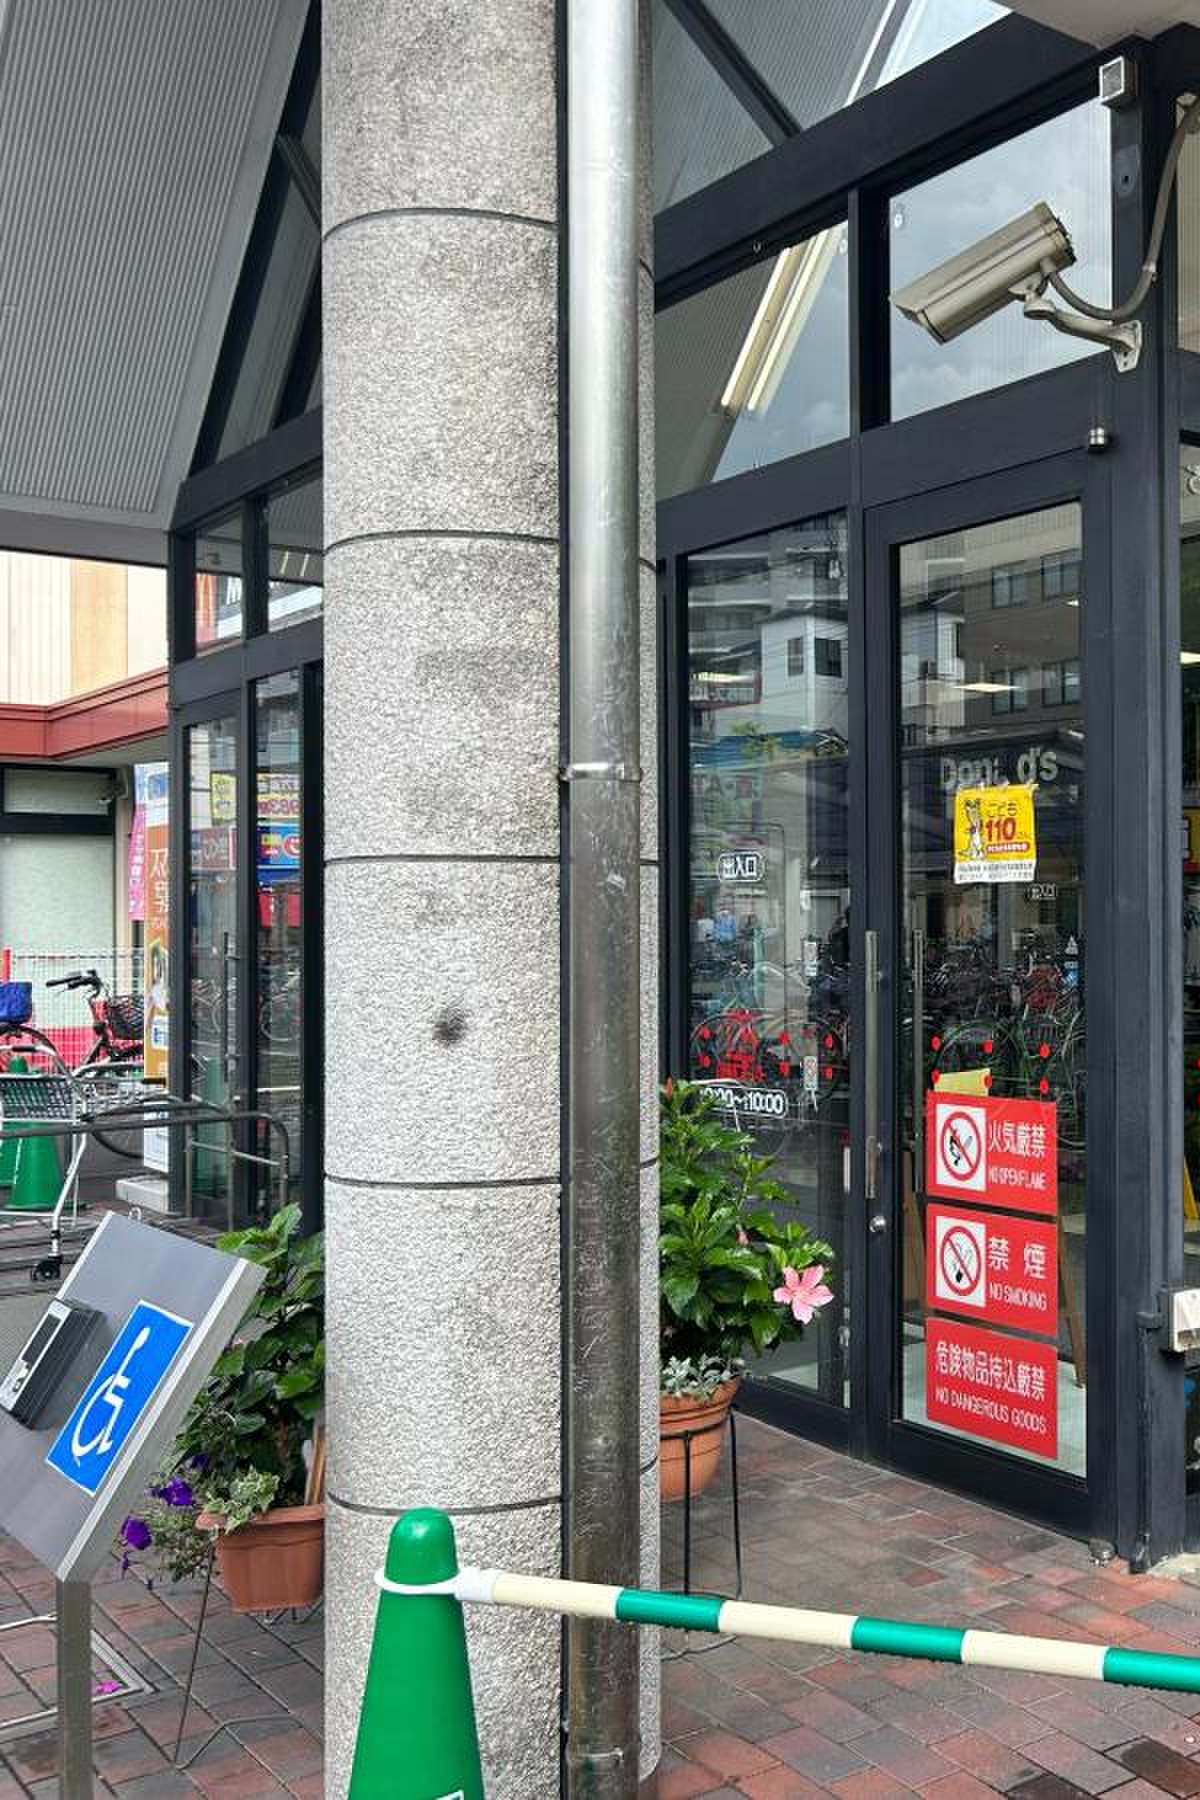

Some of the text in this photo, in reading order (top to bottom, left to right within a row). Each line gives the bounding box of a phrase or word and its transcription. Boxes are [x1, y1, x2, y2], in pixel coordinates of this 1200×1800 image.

[988, 1119, 1046, 1158] 火気厳禁
[989, 1281, 1047, 1312] NO SMOKING
[935, 1340, 1045, 1402] 危険物品持込厳禁
[935, 1384, 1047, 1434] NO DANGEROUS GOODS
